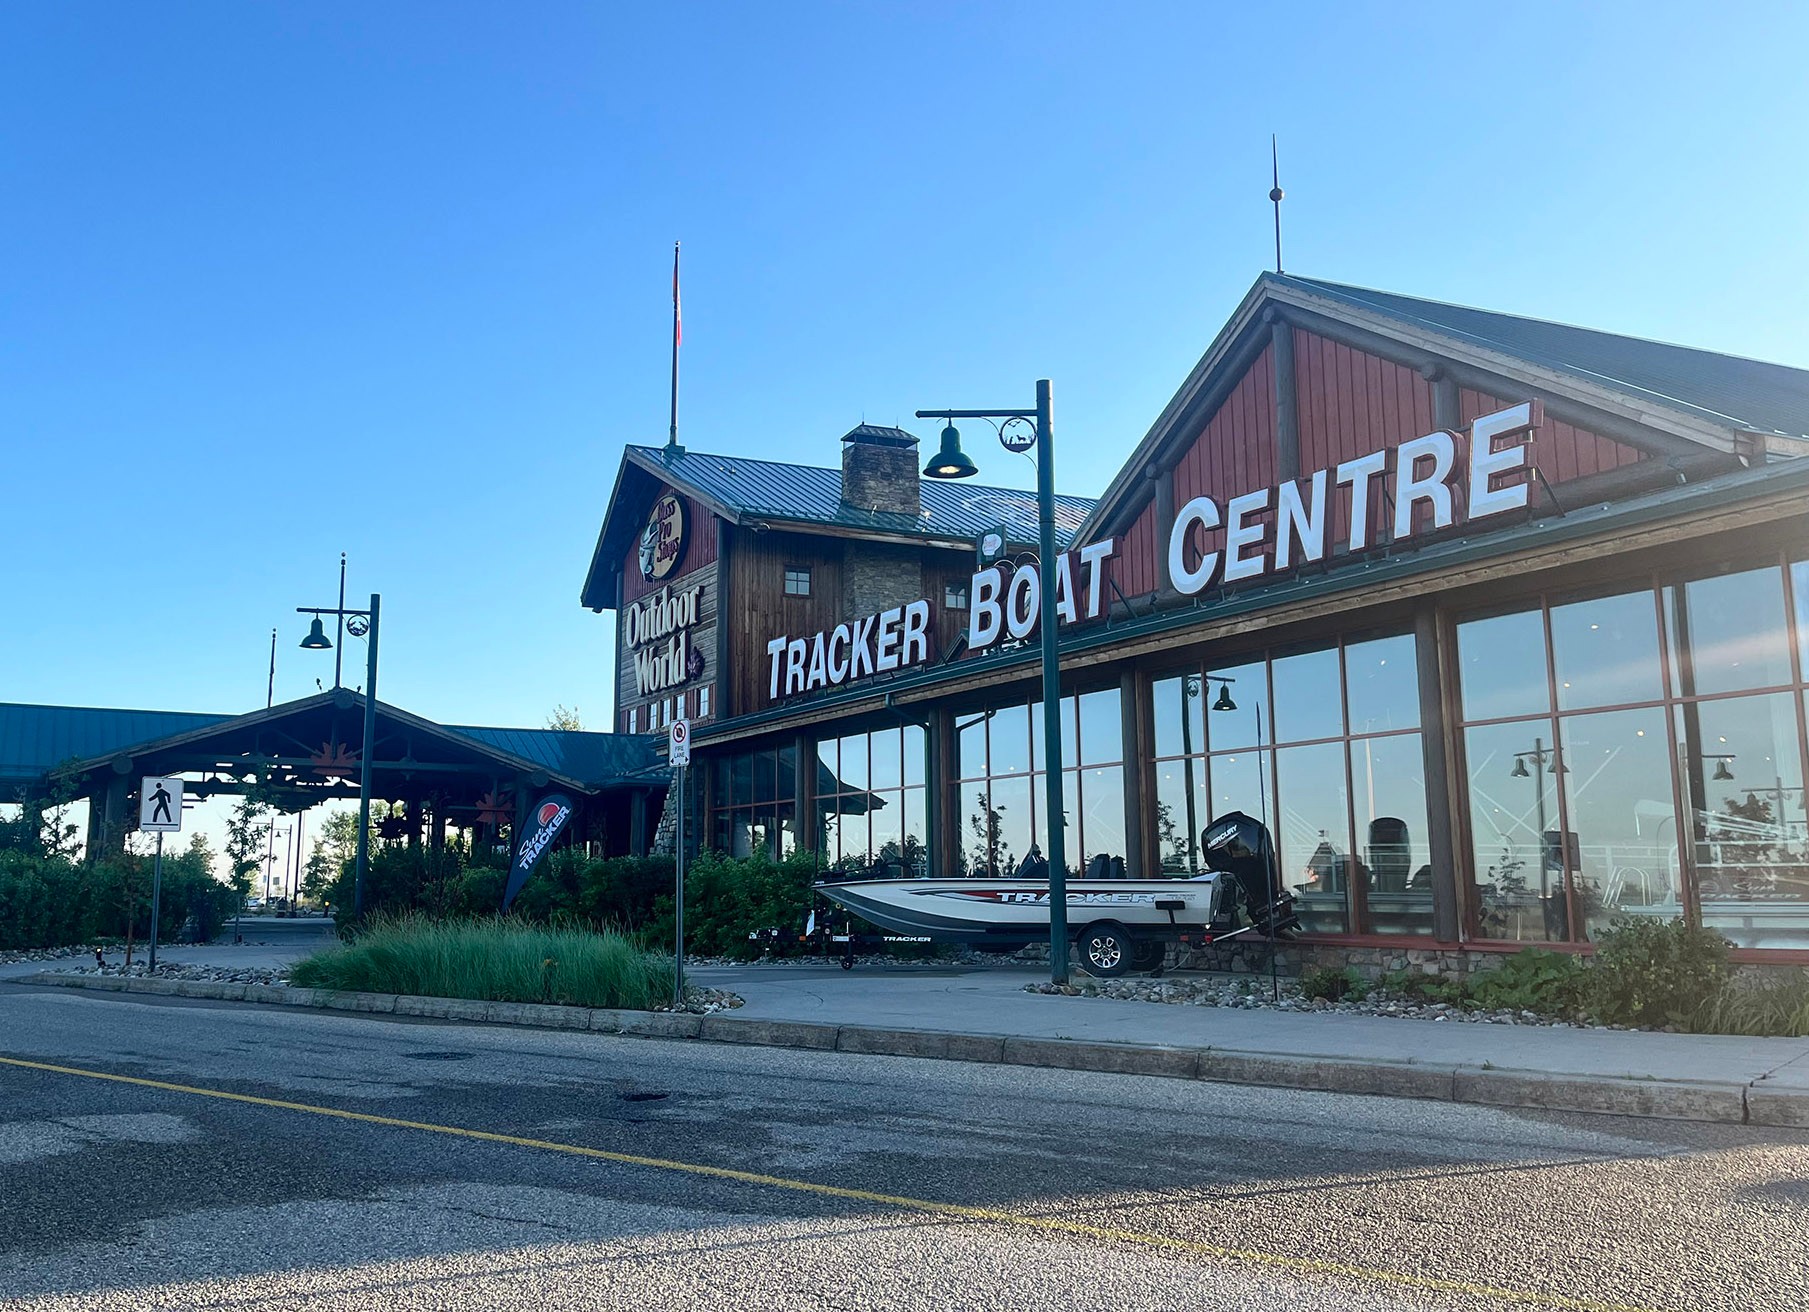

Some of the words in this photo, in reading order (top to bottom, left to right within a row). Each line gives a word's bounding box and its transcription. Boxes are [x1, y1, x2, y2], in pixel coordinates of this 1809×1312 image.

[657, 537, 679, 562] Shops
[658, 521, 672, 542] Pro
[767, 600, 929, 699] TRACKER
[968, 538, 1114, 649] BOAT
[1168, 402, 1531, 594] CENTRE
[626, 585, 701, 649] Outdoor
[634, 631, 687, 697] World
[519, 806, 571, 870] TRACKER
[1207, 824, 1238, 850] MERCURY
